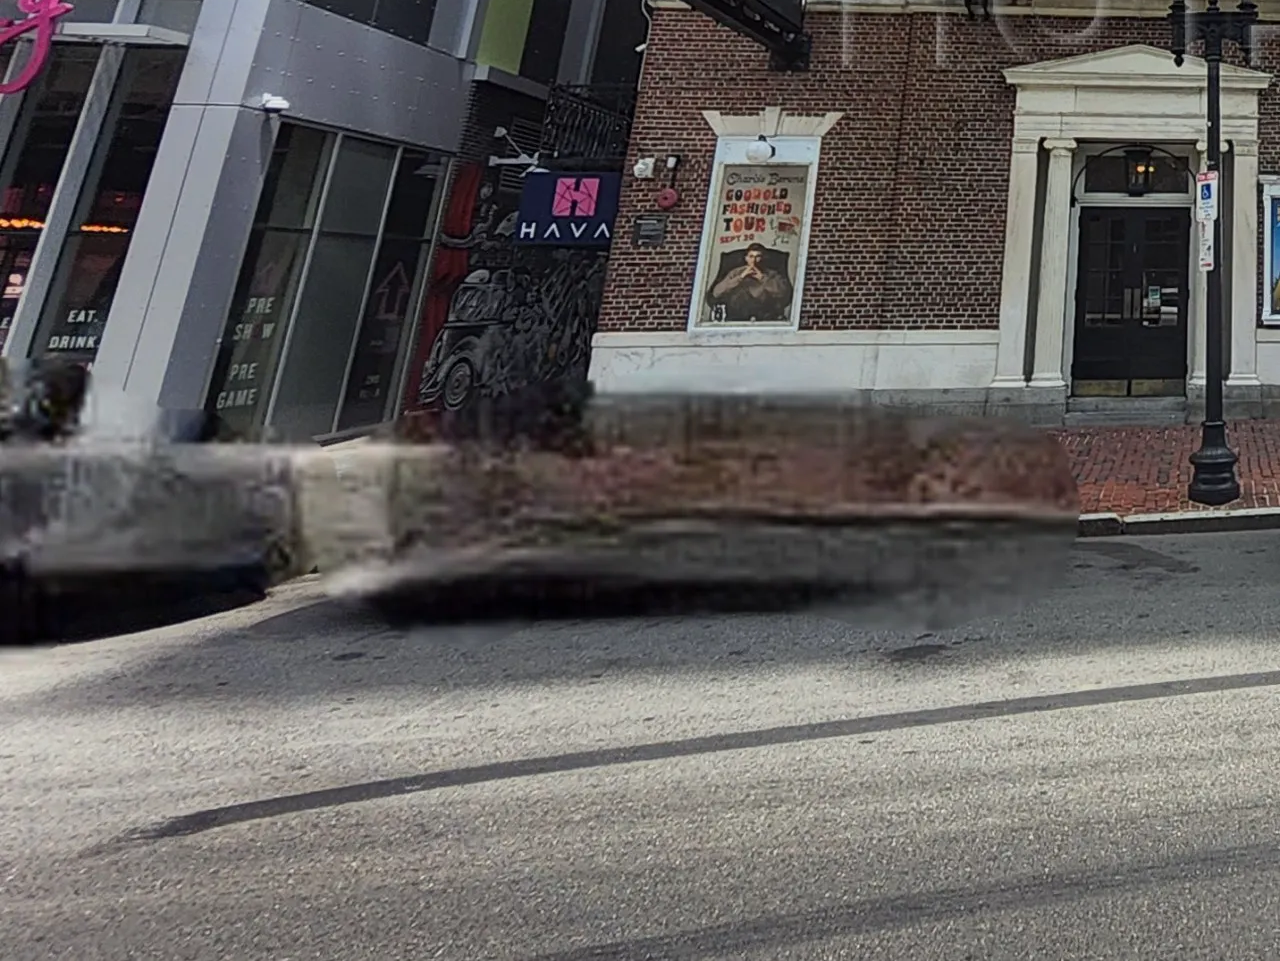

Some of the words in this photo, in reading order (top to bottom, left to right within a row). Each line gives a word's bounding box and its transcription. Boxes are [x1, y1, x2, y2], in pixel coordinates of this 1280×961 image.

[726, 188, 760, 202] GOOD
[762, 187, 788, 201] OLD
[722, 201, 792, 215] FASHIONED
[724, 217, 766, 233] TOUR
[245, 297, 275, 313] PRE
[67, 309, 98, 323] EAT.
[232, 323, 275, 340] SHW
[229, 363, 258, 380] PRE
[216, 389, 257, 409] GAME
